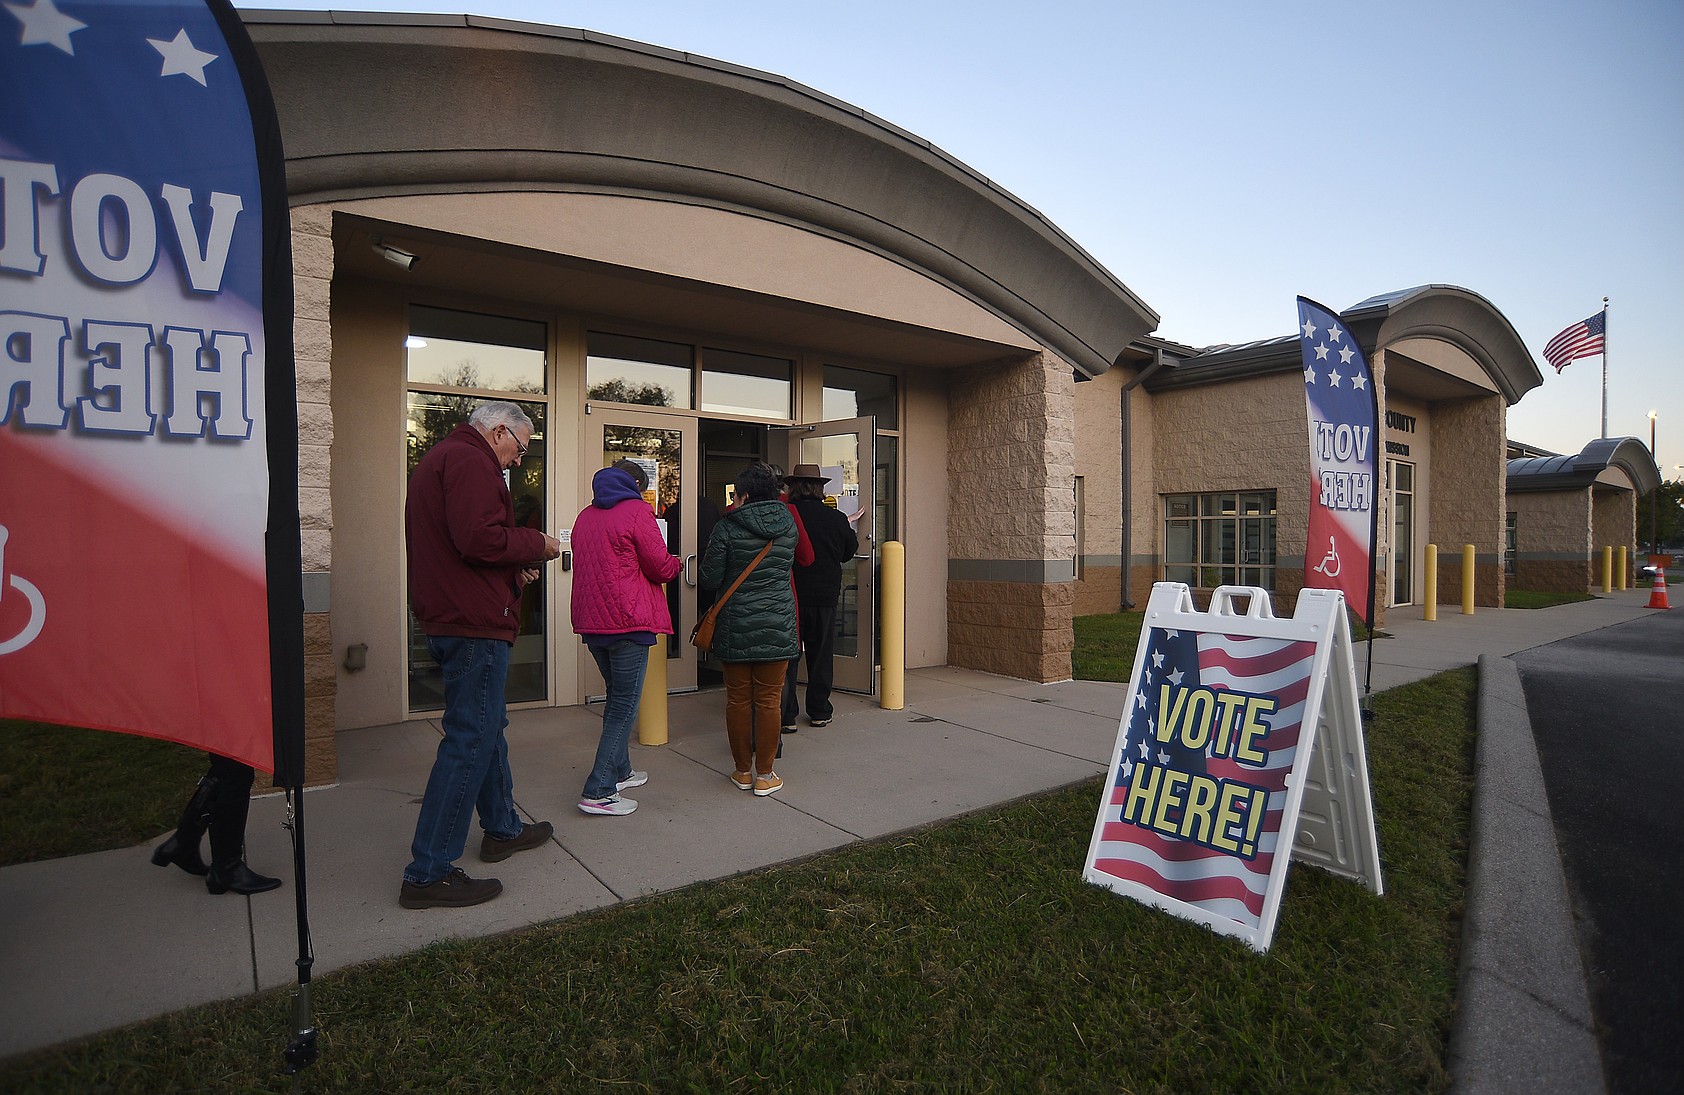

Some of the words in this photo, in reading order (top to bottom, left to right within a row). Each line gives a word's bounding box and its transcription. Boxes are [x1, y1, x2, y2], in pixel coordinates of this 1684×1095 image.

[1385, 410, 1416, 433] OUNTY
[1155, 683, 1277, 764] VOTE
[1122, 760, 1268, 859] HERE!
